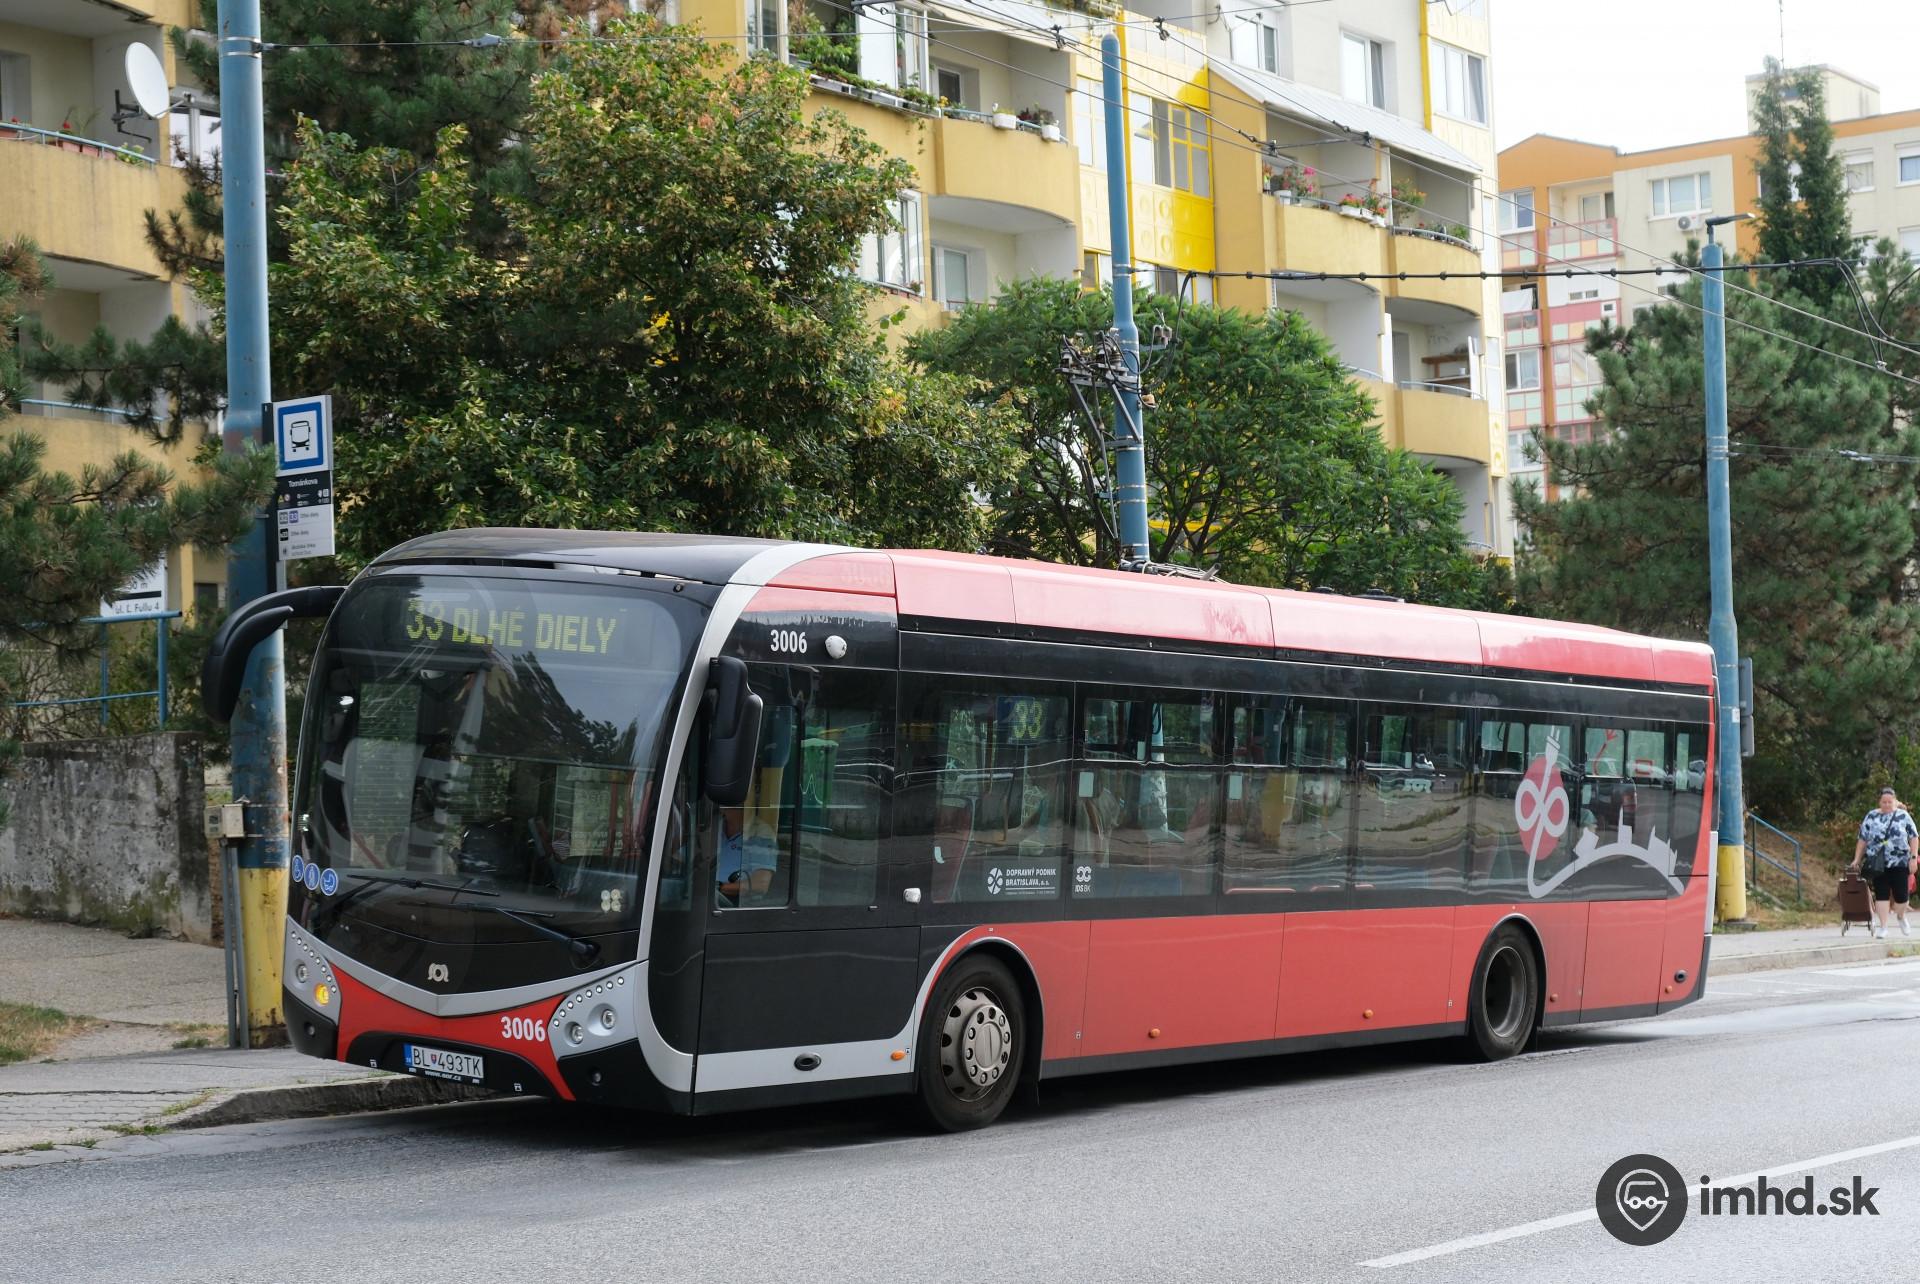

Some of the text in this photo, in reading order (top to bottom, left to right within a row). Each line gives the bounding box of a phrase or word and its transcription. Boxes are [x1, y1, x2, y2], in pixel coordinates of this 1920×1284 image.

[407, 598, 617, 653] 33 DLHÉ DIELY
[770, 629, 808, 654] 3006
[1006, 867, 1057, 877] DOPRAVNÝ PODNIK
[501, 1016, 546, 1042] 3006
[413, 1048, 480, 1077] BL 493TK
